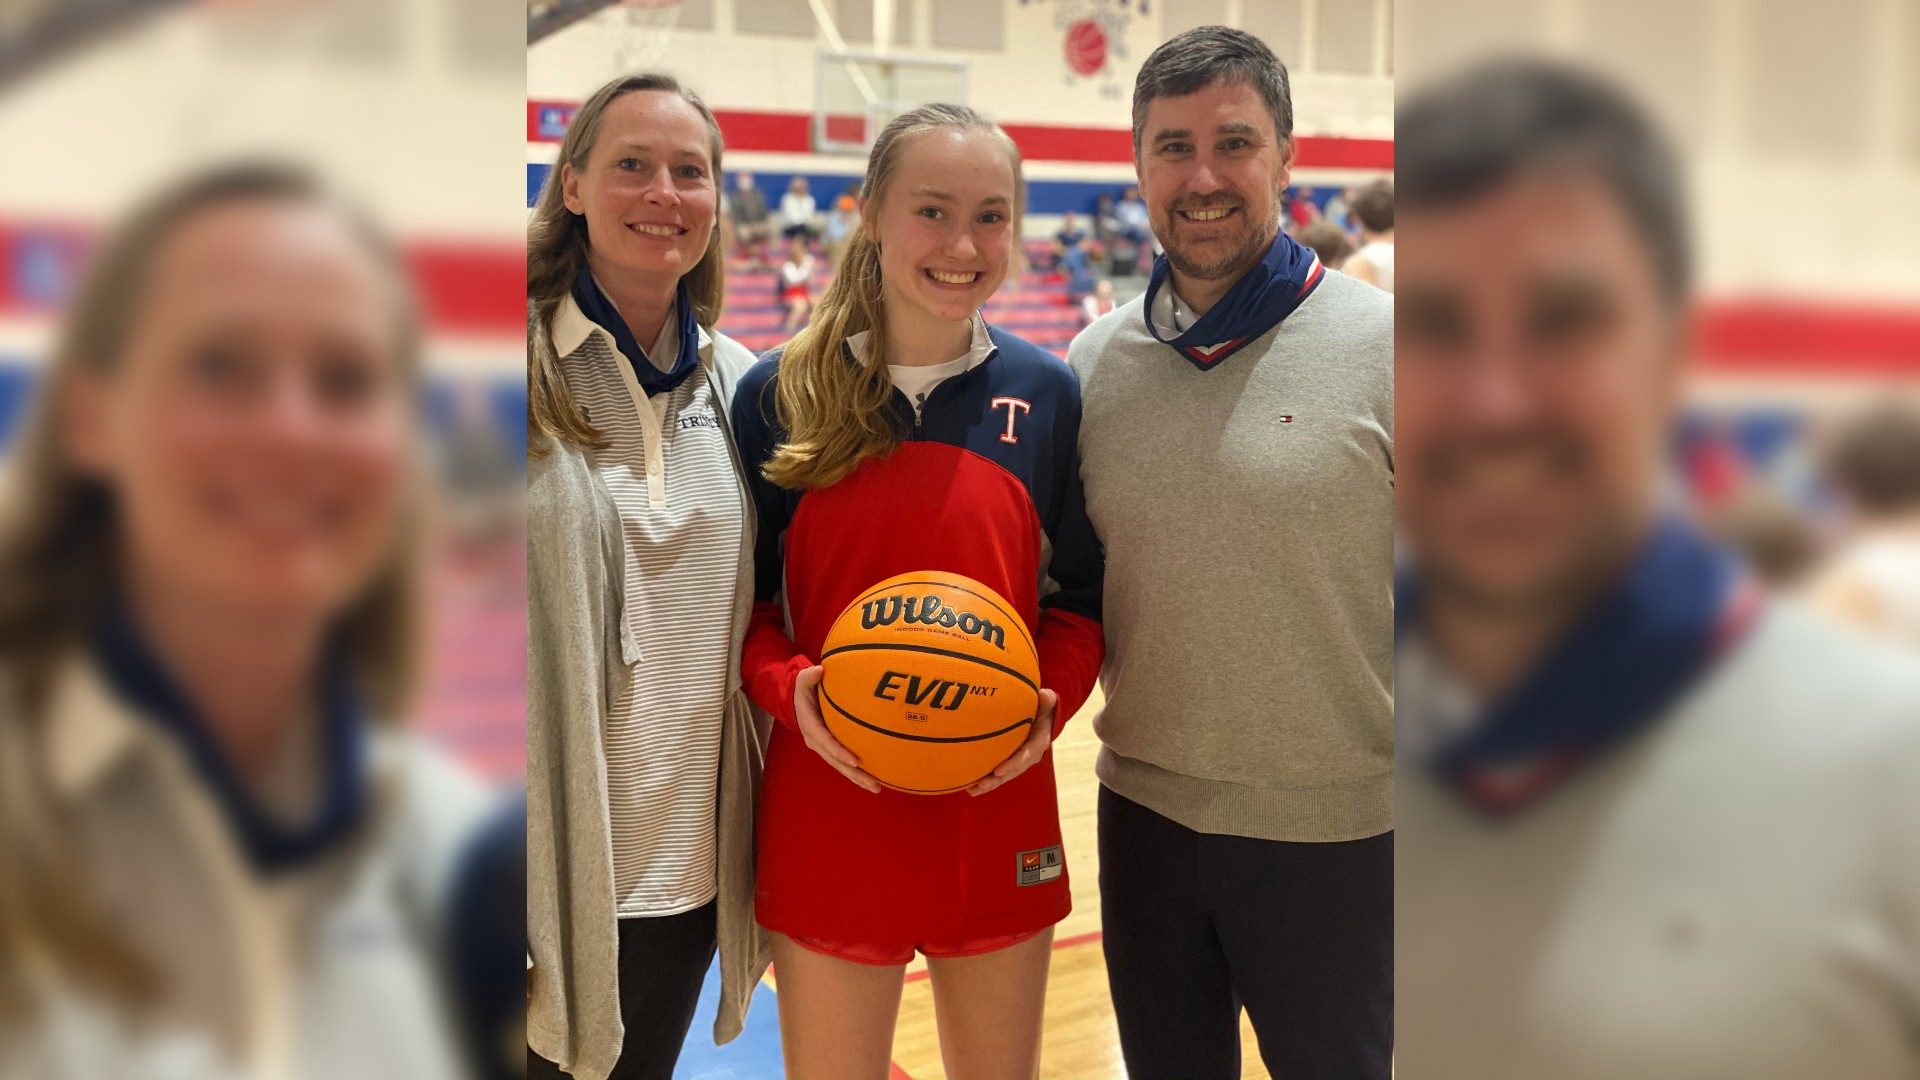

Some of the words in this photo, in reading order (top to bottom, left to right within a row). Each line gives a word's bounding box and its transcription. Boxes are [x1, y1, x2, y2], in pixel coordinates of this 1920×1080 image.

[991, 396, 1031, 445] T
[861, 594, 1006, 651] Wilson
[951, 633, 970, 642] BALL
[873, 671, 970, 711] EVO
[969, 685, 998, 697] NXT
[1046, 852, 1056, 864] M
